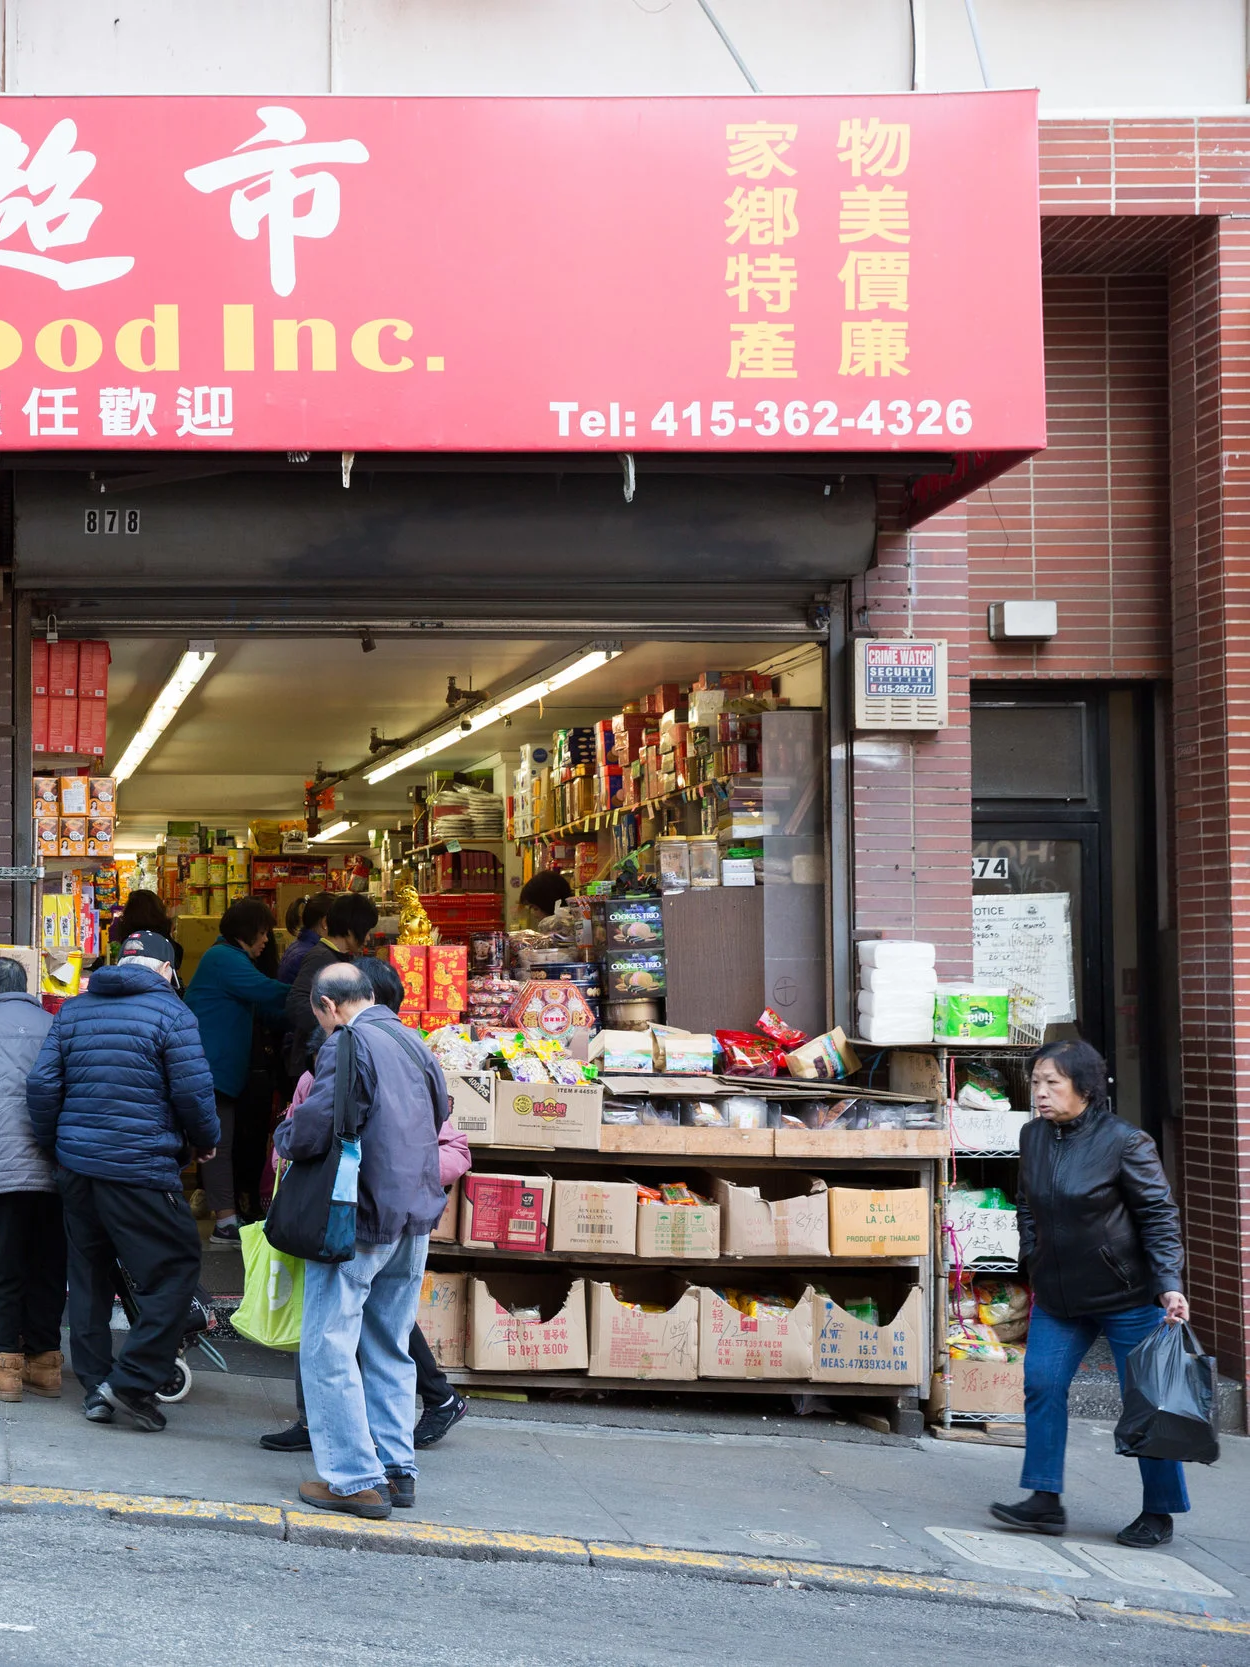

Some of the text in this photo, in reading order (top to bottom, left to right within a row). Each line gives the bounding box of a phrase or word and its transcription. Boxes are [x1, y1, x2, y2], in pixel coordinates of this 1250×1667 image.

[724, 120, 799, 379] 家鄉特產
[836, 117, 911, 377] 物美價廉
[222, 304, 445, 373] Inc.
[550, 399, 973, 437] Tel: 415-362-4326
[86, 510, 138, 533] 878
[869, 650, 933, 665] CRIME WATCH
[870, 667, 931, 676] SECURITY
[878, 685, 932, 693] 415-282-7777
[610, 912, 641, 920] COOKIES
[973, 906, 1005, 916] OTICE
[611, 962, 643, 970] COOKIES
[884, 1215, 896, 1223] CA
[859, 1330, 878, 1341] 14.4
[894, 1331, 905, 1342] KG
[770, 1350, 782, 1358] KGS
[821, 1343, 904, 1356] G.W: 15.5 KG
[744, 1359, 761, 1367] 27.24
[770, 1359, 782, 1367] KGS
[894, 1360, 908, 1370] CM
